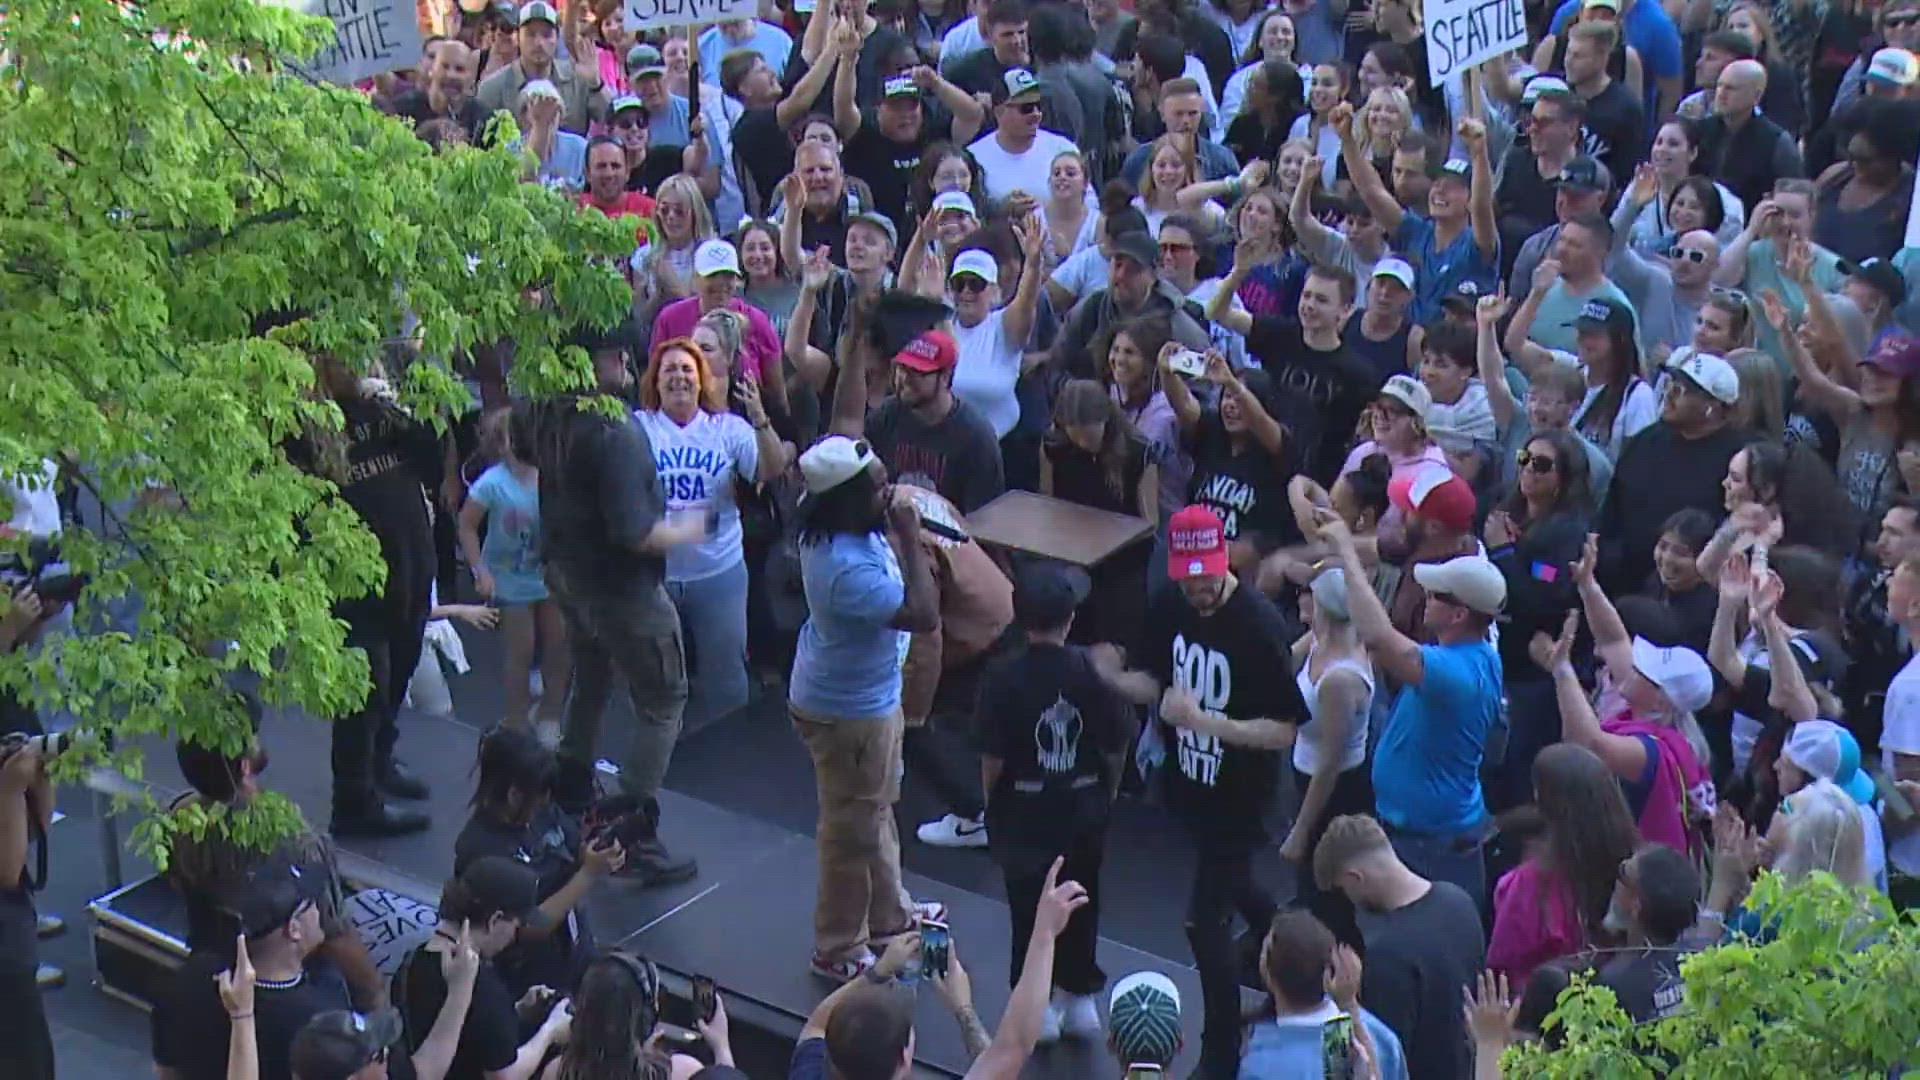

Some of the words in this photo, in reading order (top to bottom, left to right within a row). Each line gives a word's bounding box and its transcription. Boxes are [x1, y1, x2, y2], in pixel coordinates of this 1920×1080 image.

[1431, 0, 1524, 75] SEATTLE
[661, 474, 705, 501] USA
[1172, 632, 1231, 709] GOD
